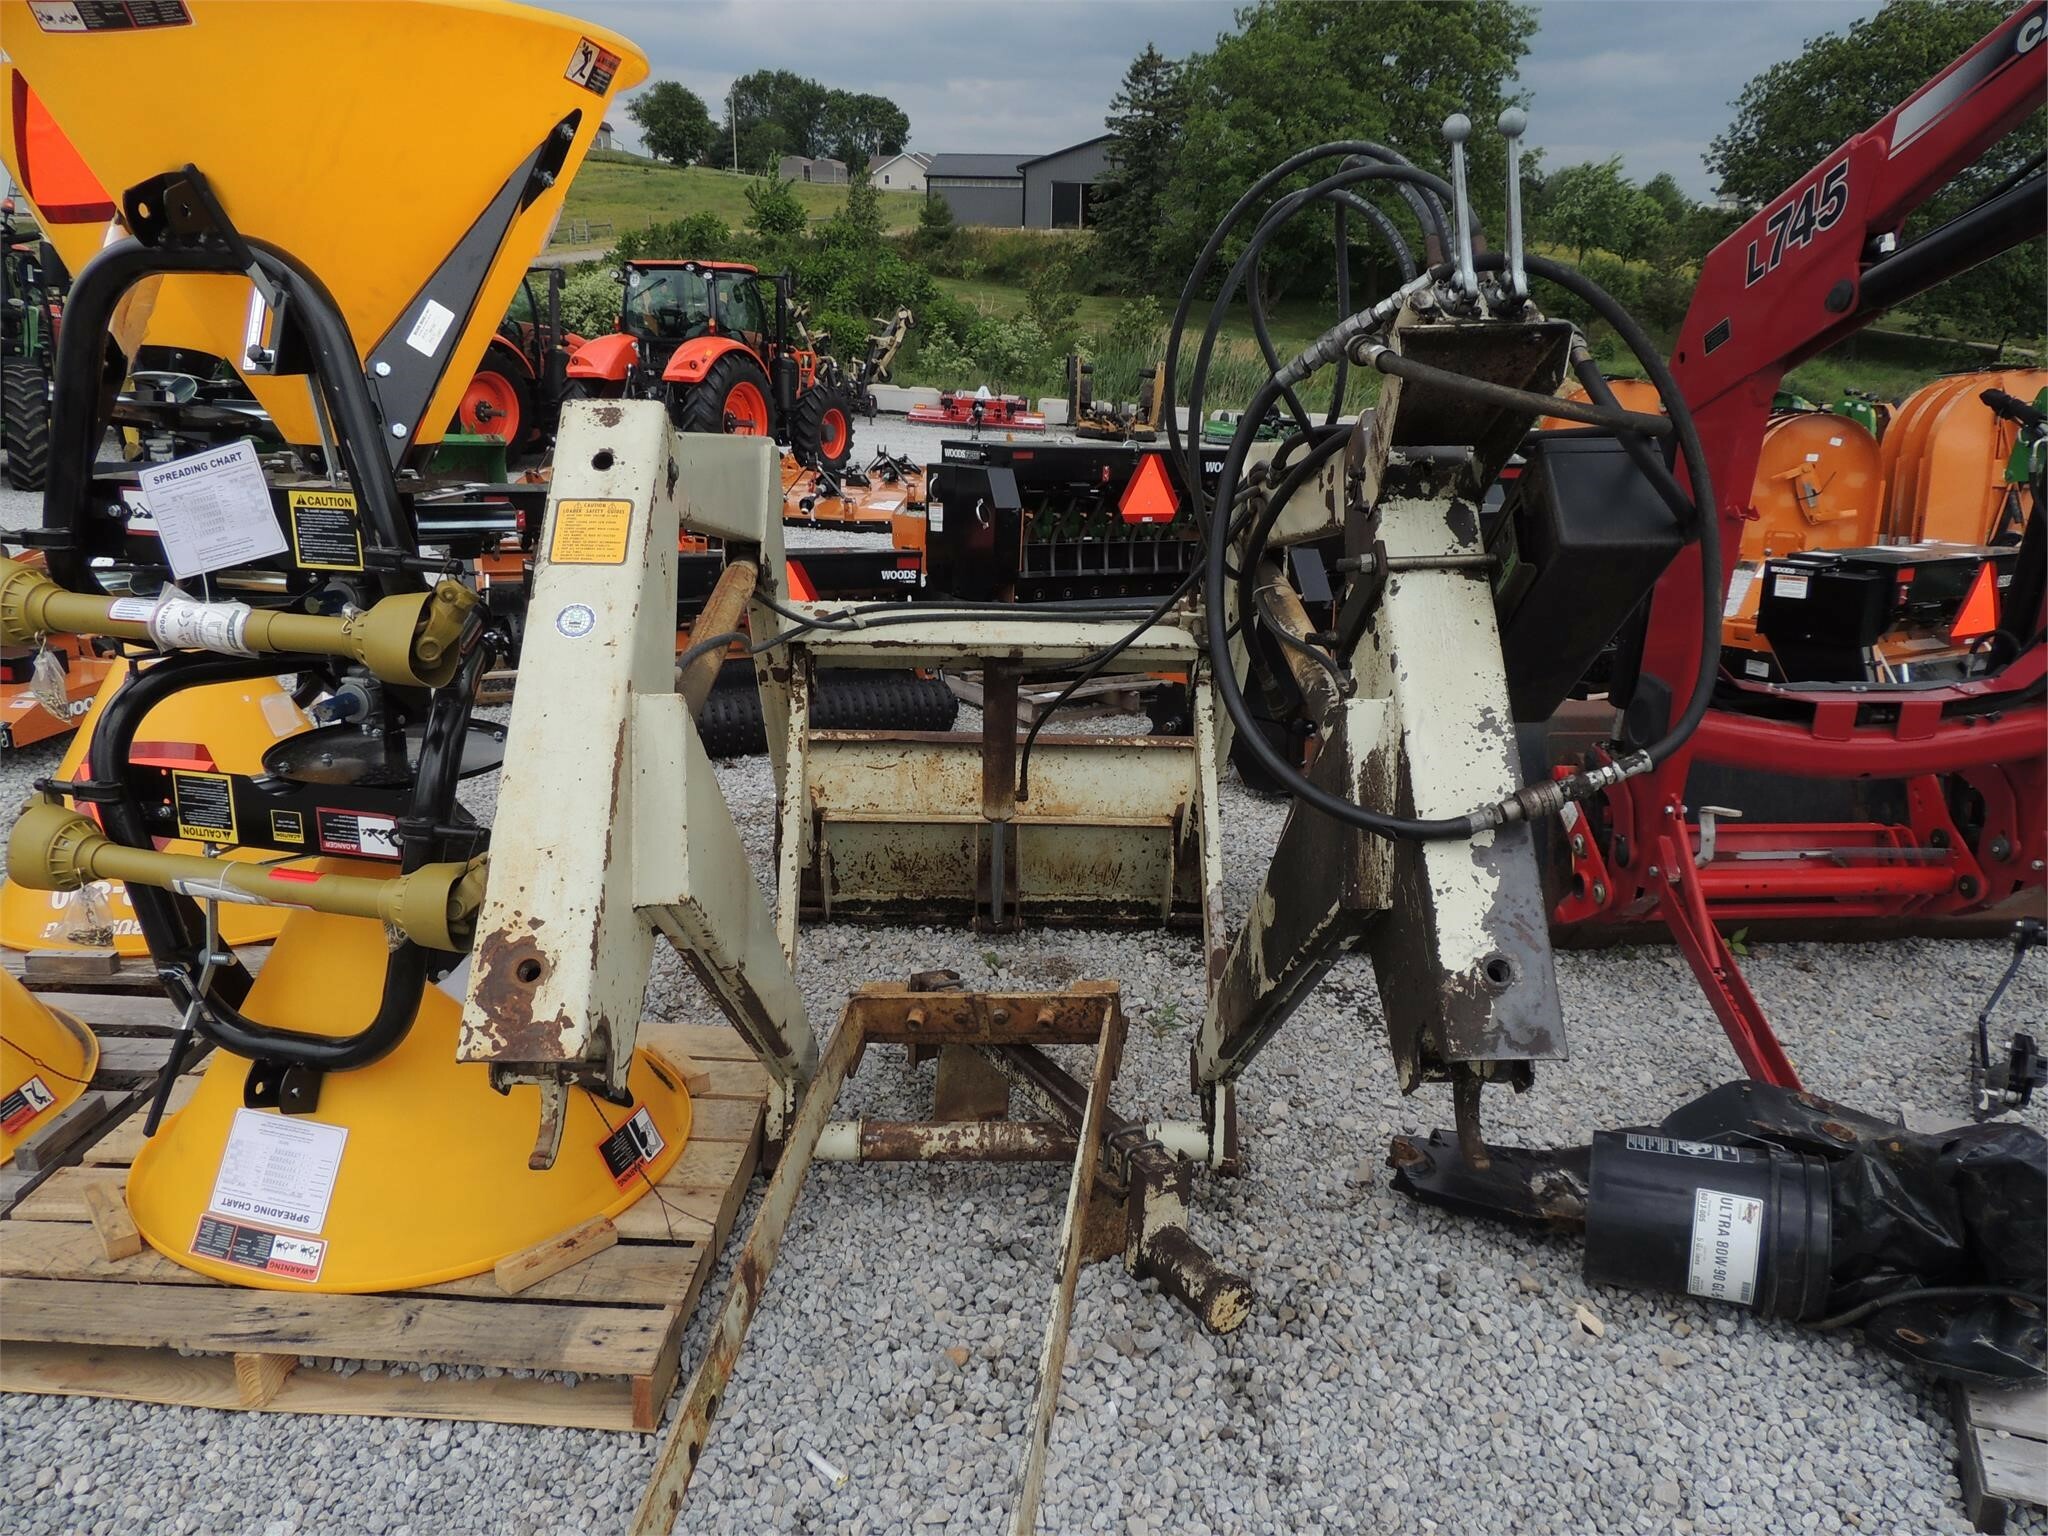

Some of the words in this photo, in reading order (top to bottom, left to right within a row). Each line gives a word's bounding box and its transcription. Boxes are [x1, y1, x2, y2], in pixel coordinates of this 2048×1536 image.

[1745, 157, 1849, 289] L745
[944, 448, 966, 459] WOODS
[153, 462, 208, 485] SPREADING
[210, 452, 242, 469] CHART
[307, 496, 352, 507] CAUTION
[881, 570, 917, 580] WOODS
[183, 826, 222, 839] CAUTION
[325, 840, 352, 850] DANGER
[220, 1197, 251, 1211] CHART
[254, 1206, 311, 1224] SPREADING
[1718, 1197, 1734, 1236] ULTRA
[269, 1261, 311, 1275] WARNING
[1713, 1240, 1729, 1282] 80W-90
